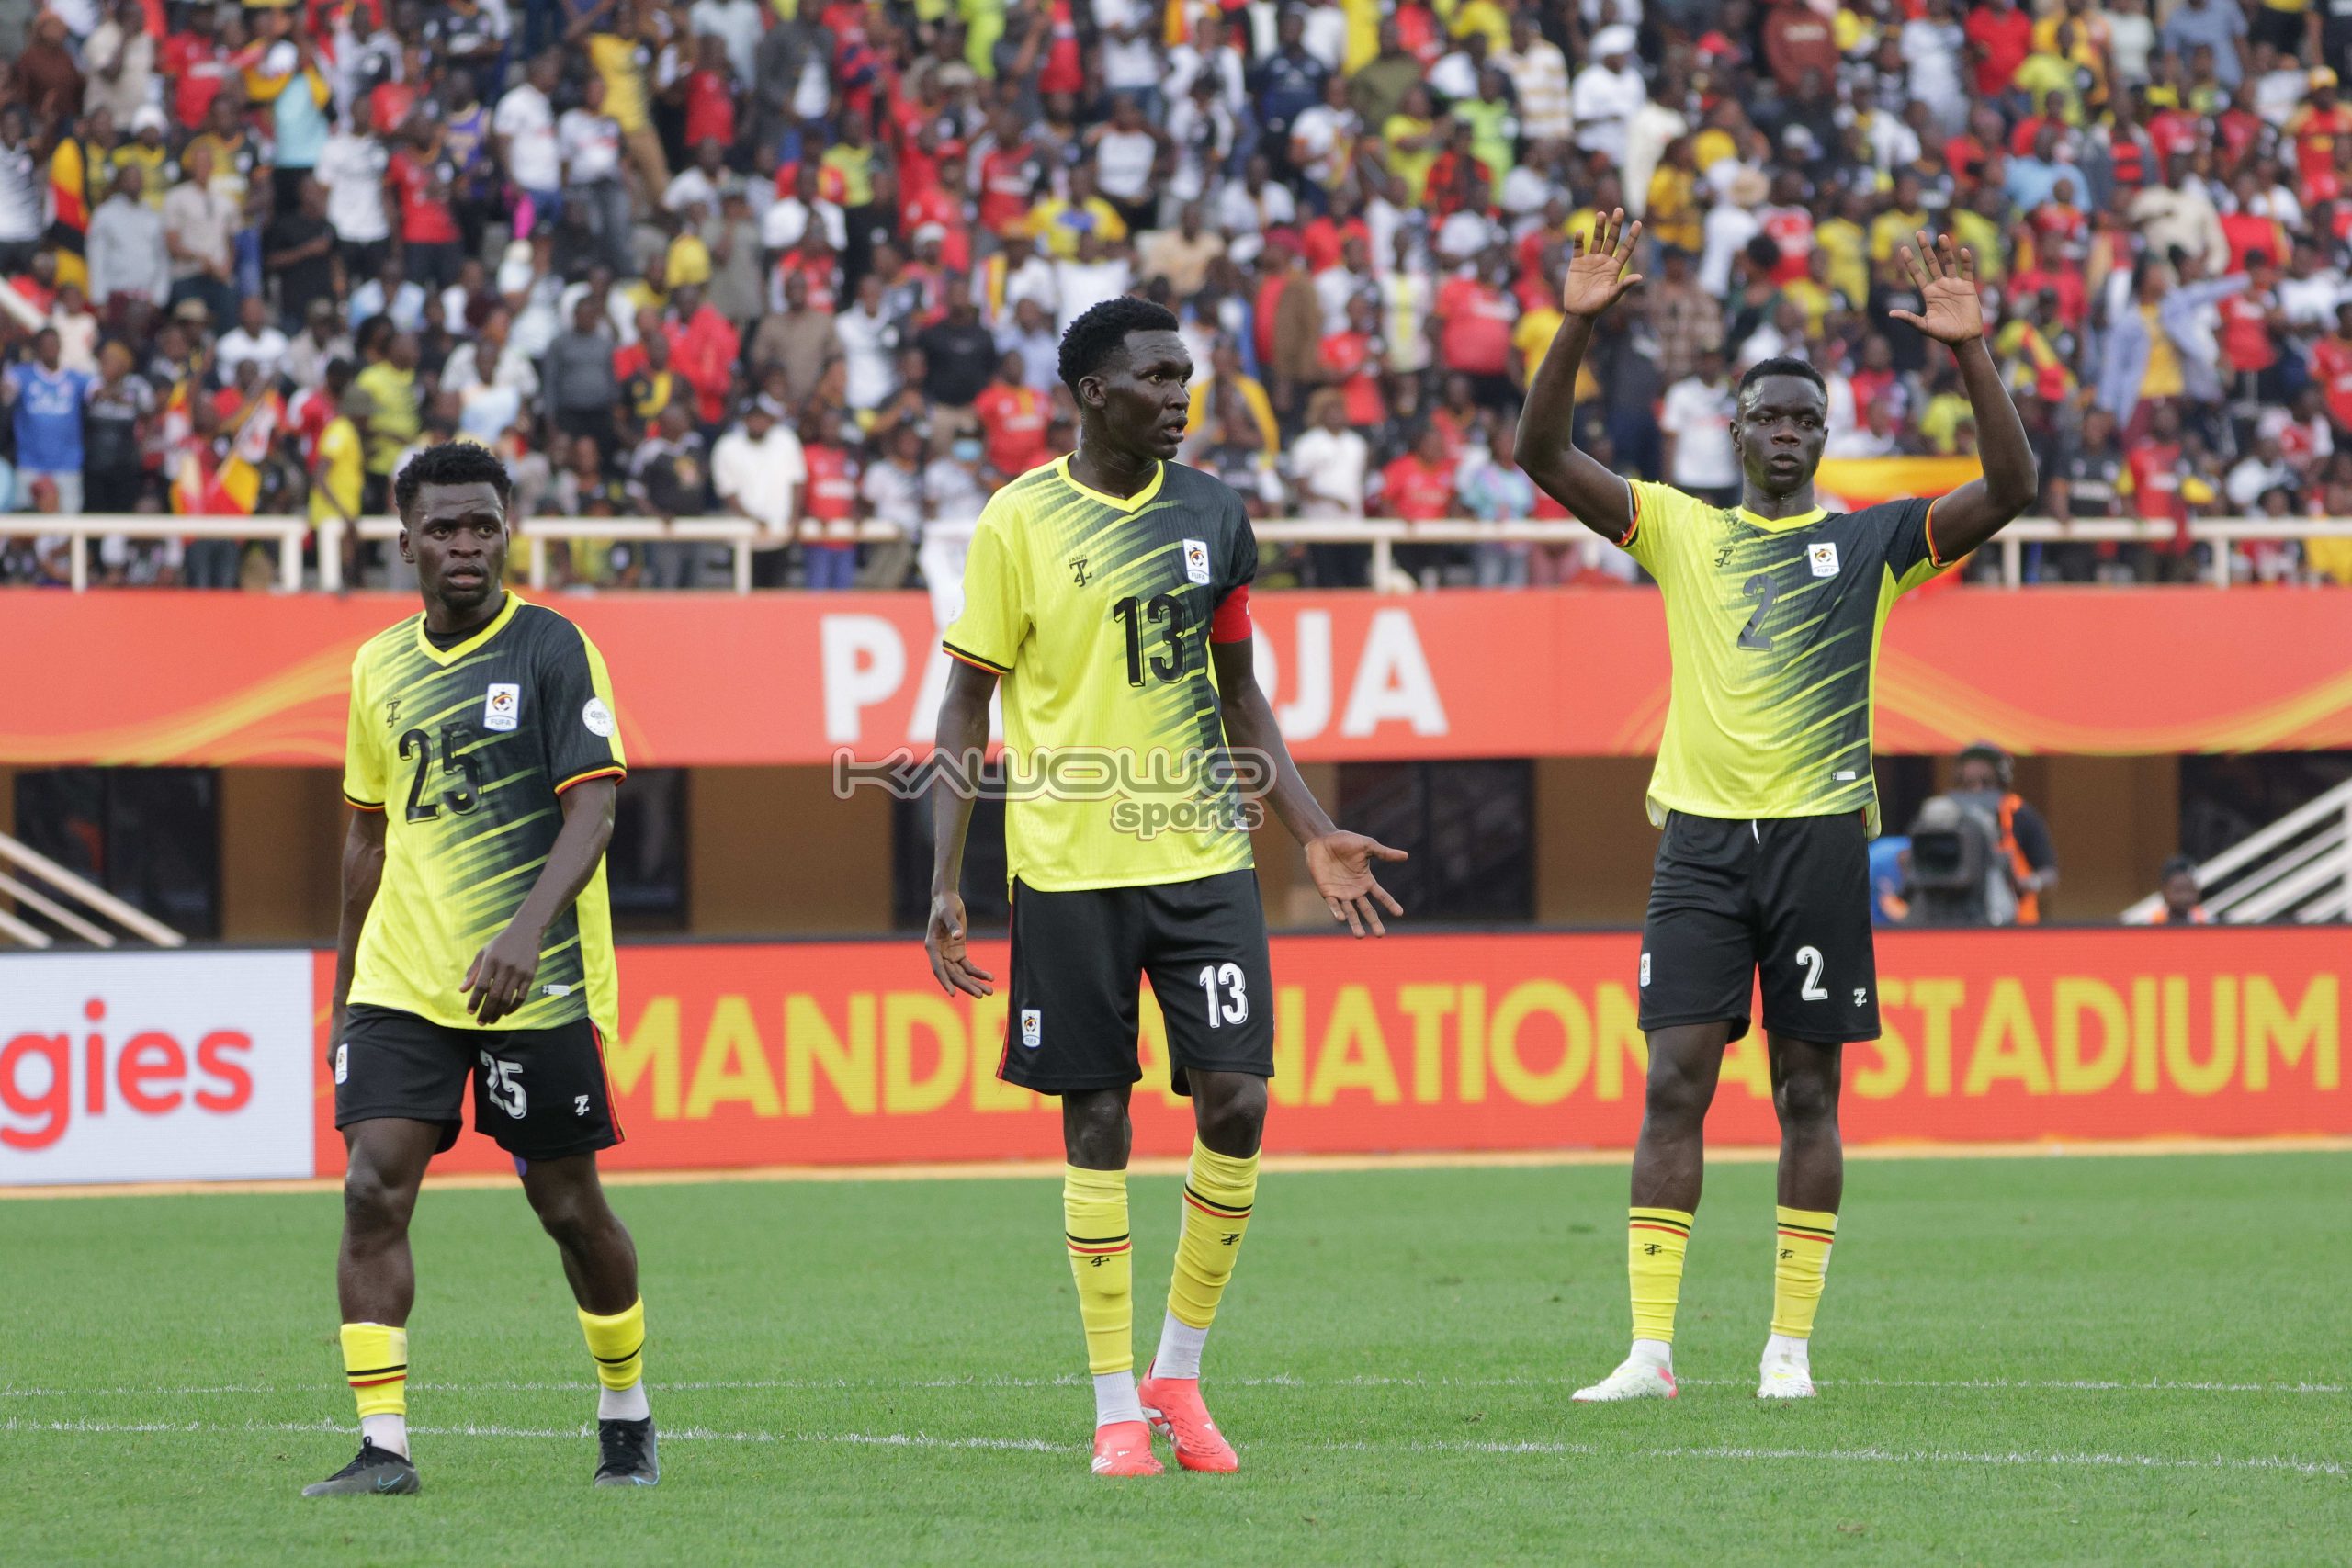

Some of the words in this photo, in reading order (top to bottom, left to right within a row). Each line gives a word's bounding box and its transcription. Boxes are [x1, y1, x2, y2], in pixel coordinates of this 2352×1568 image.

[1191, 571, 1206, 581] FUFA
[1737, 574, 1779, 651] 2
[1113, 593, 1186, 687] 13
[491, 718, 511, 727] FUFA
[399, 722, 484, 824] 25
[1199, 963, 1248, 1029] 13
[1796, 945, 1828, 1001] 2
[0, 995, 254, 1152] gies
[608, 989, 1193, 1120] MANDE
[1853, 974, 2339, 1099] STADIUM
[480, 1049, 526, 1119] 25
